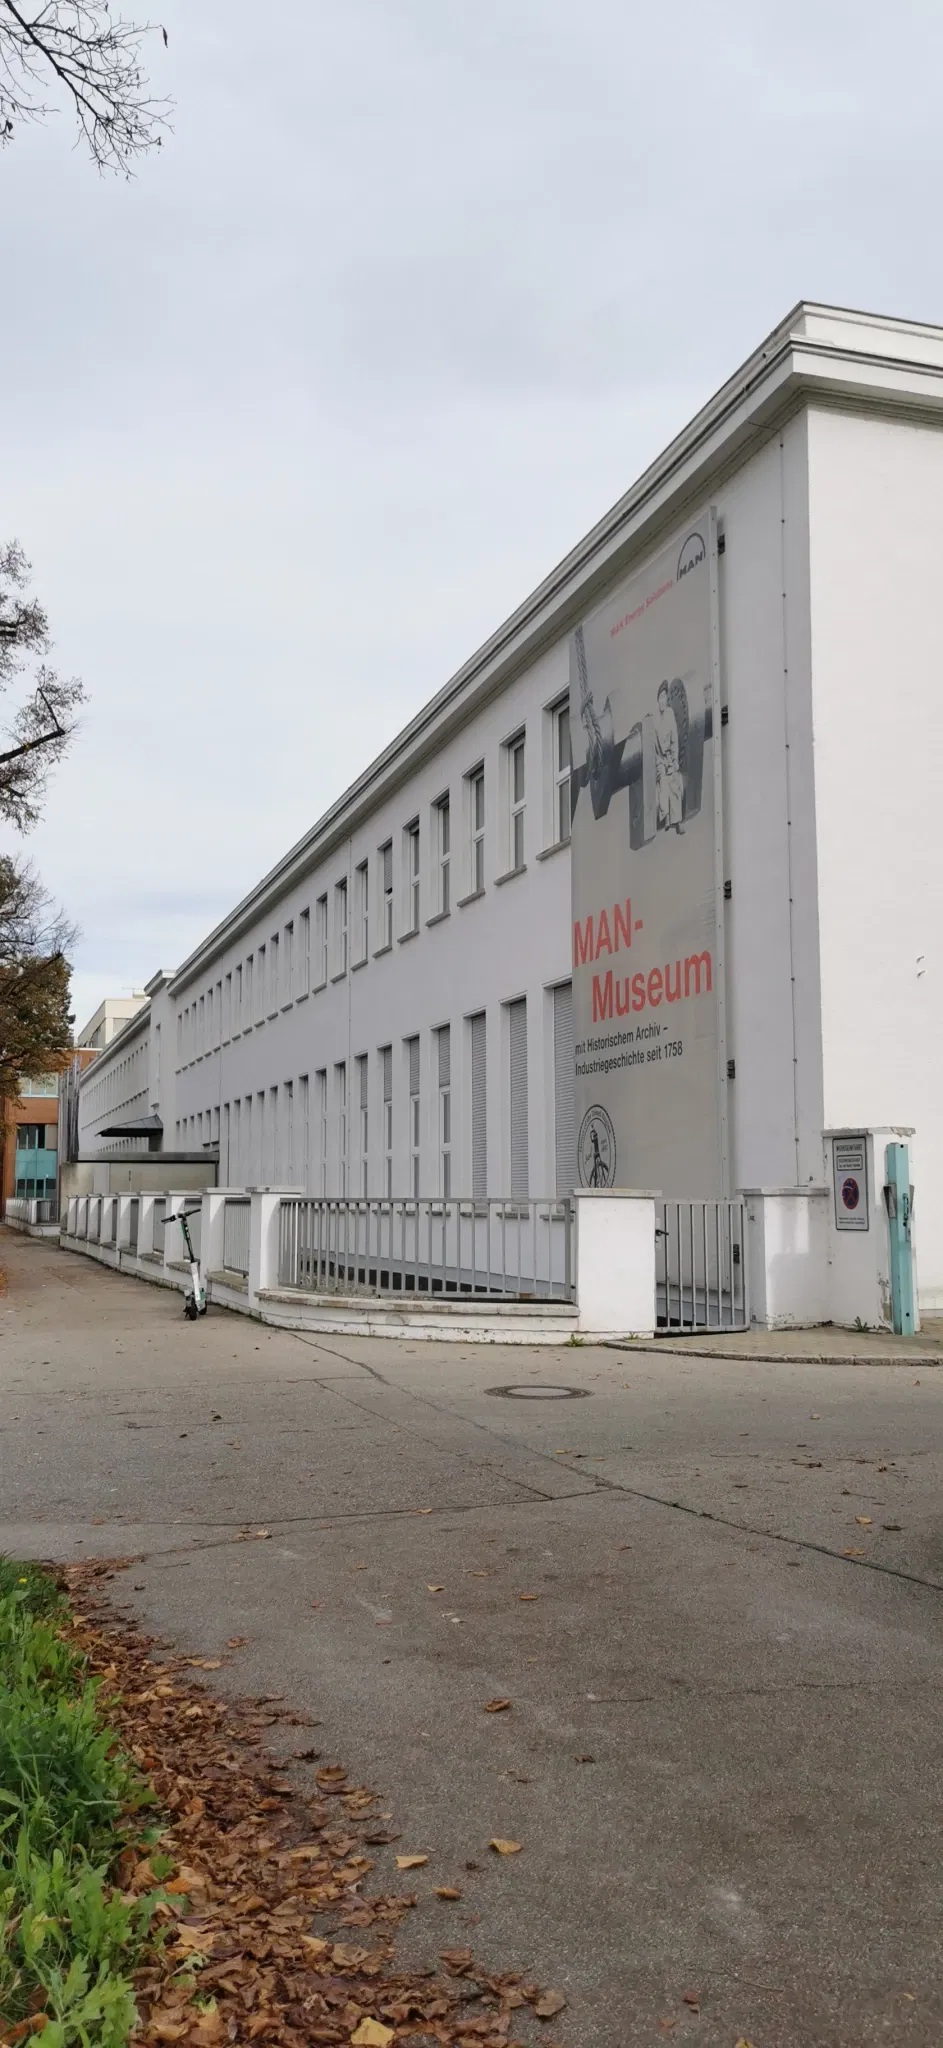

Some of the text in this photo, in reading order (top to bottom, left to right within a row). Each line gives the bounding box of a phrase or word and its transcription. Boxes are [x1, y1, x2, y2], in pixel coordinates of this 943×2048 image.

[679, 551, 704, 579] MAN
[625, 605, 645, 627] Energy
[645, 579, 673, 608] Solutions
[573, 898, 643, 968] MAN-
[592, 951, 712, 1023] Museum
[575, 1040, 586, 1056] mit
[587, 1029, 634, 1053] Historischem
[635, 1021, 661, 1042] Archiv
[575, 1040, 683, 1076] Industriegeschichte seit 1758
